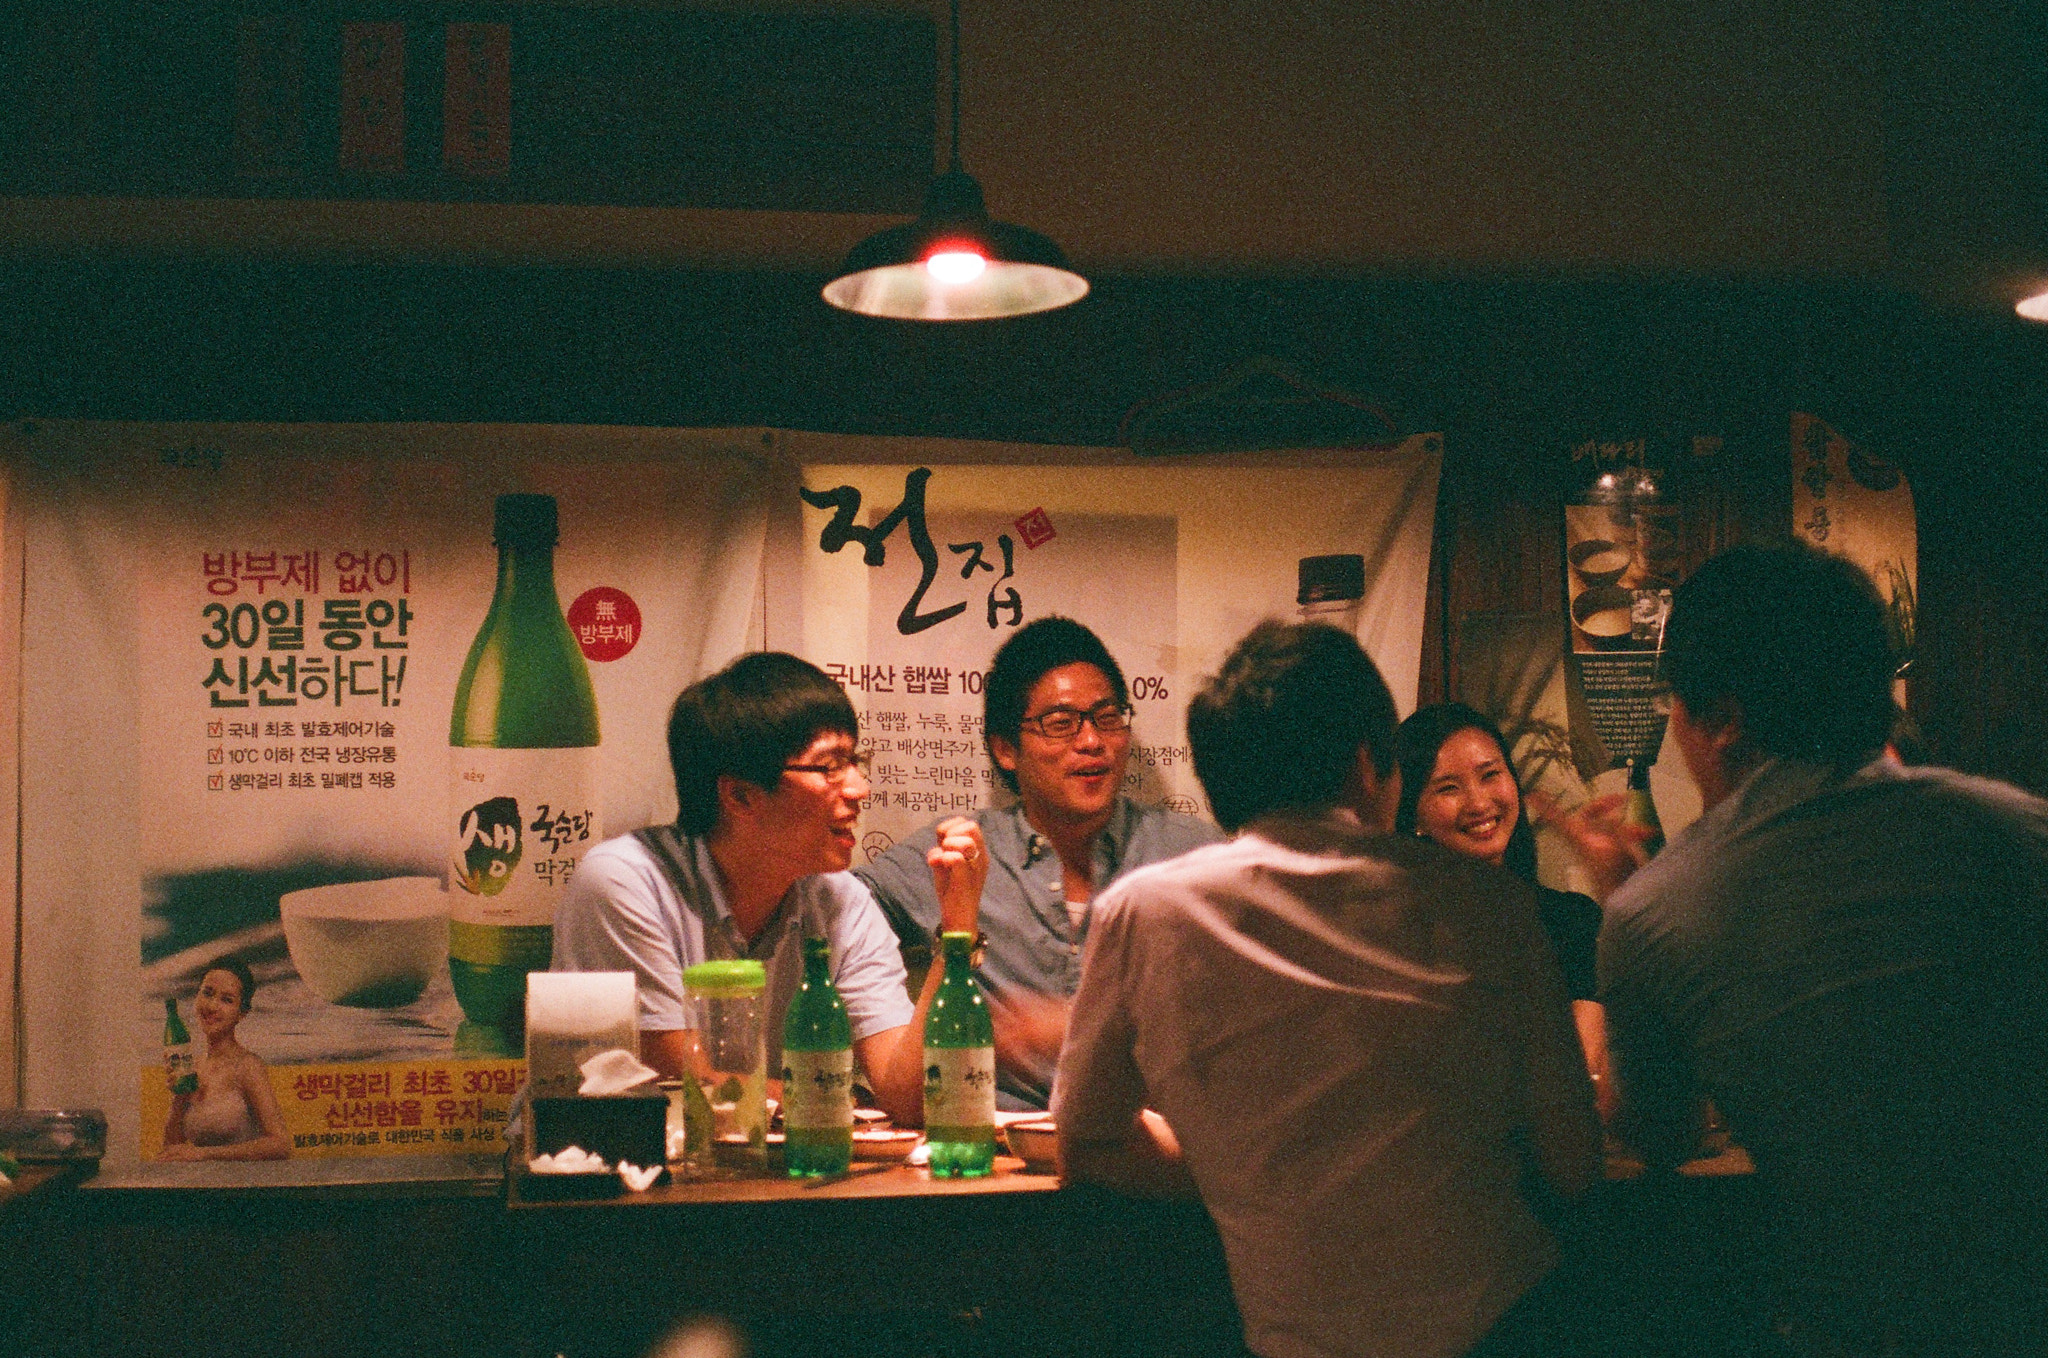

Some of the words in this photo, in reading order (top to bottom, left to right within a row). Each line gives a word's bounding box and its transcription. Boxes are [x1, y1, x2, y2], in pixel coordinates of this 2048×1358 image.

[800, 466, 1023, 635] 전집
[203, 550, 319, 596] 방부제
[335, 550, 409, 595] 없이
[595, 599, 617, 621] 無
[202, 599, 305, 651] 30일
[319, 598, 413, 651] 동안
[579, 624, 633, 645] 방부제
[202, 655, 407, 708] 신선하다!
[826, 662, 896, 694] 국내산
[902, 665, 951, 695] 햅쌀
[228, 722, 258, 738] 국내
[265, 721, 295, 738] 최초
[301, 721, 396, 738] 발효제어기술
[857, 710, 872, 731] 산
[876, 711, 911, 732] 햅쌀,
[916, 713, 952, 735] 누룩,
[264, 747, 294, 763] 이하
[300, 747, 330, 763] 전국
[336, 746, 397, 763] 냉장유통
[897, 737, 976, 760] 배상면주가
[228, 774, 282, 790] 생막걸리
[288, 773, 316, 789] 최초
[321, 773, 362, 789] 밀폐캡
[368, 771, 396, 789] 적용
[877, 764, 909, 785] 빚는
[912, 765, 976, 788] 느린마을
[892, 790, 977, 812] 제공합니다!
[530, 804, 593, 855] 국순당
[458, 804, 519, 883] 생
[534, 858, 577, 887] 막걸
[293, 1071, 390, 1101] 생막걸리
[403, 1069, 453, 1097] 최초
[326, 1099, 424, 1128] 신선함을
[385, 1128, 436, 1144] 대한민국
[470, 1126, 495, 1142] 사상
